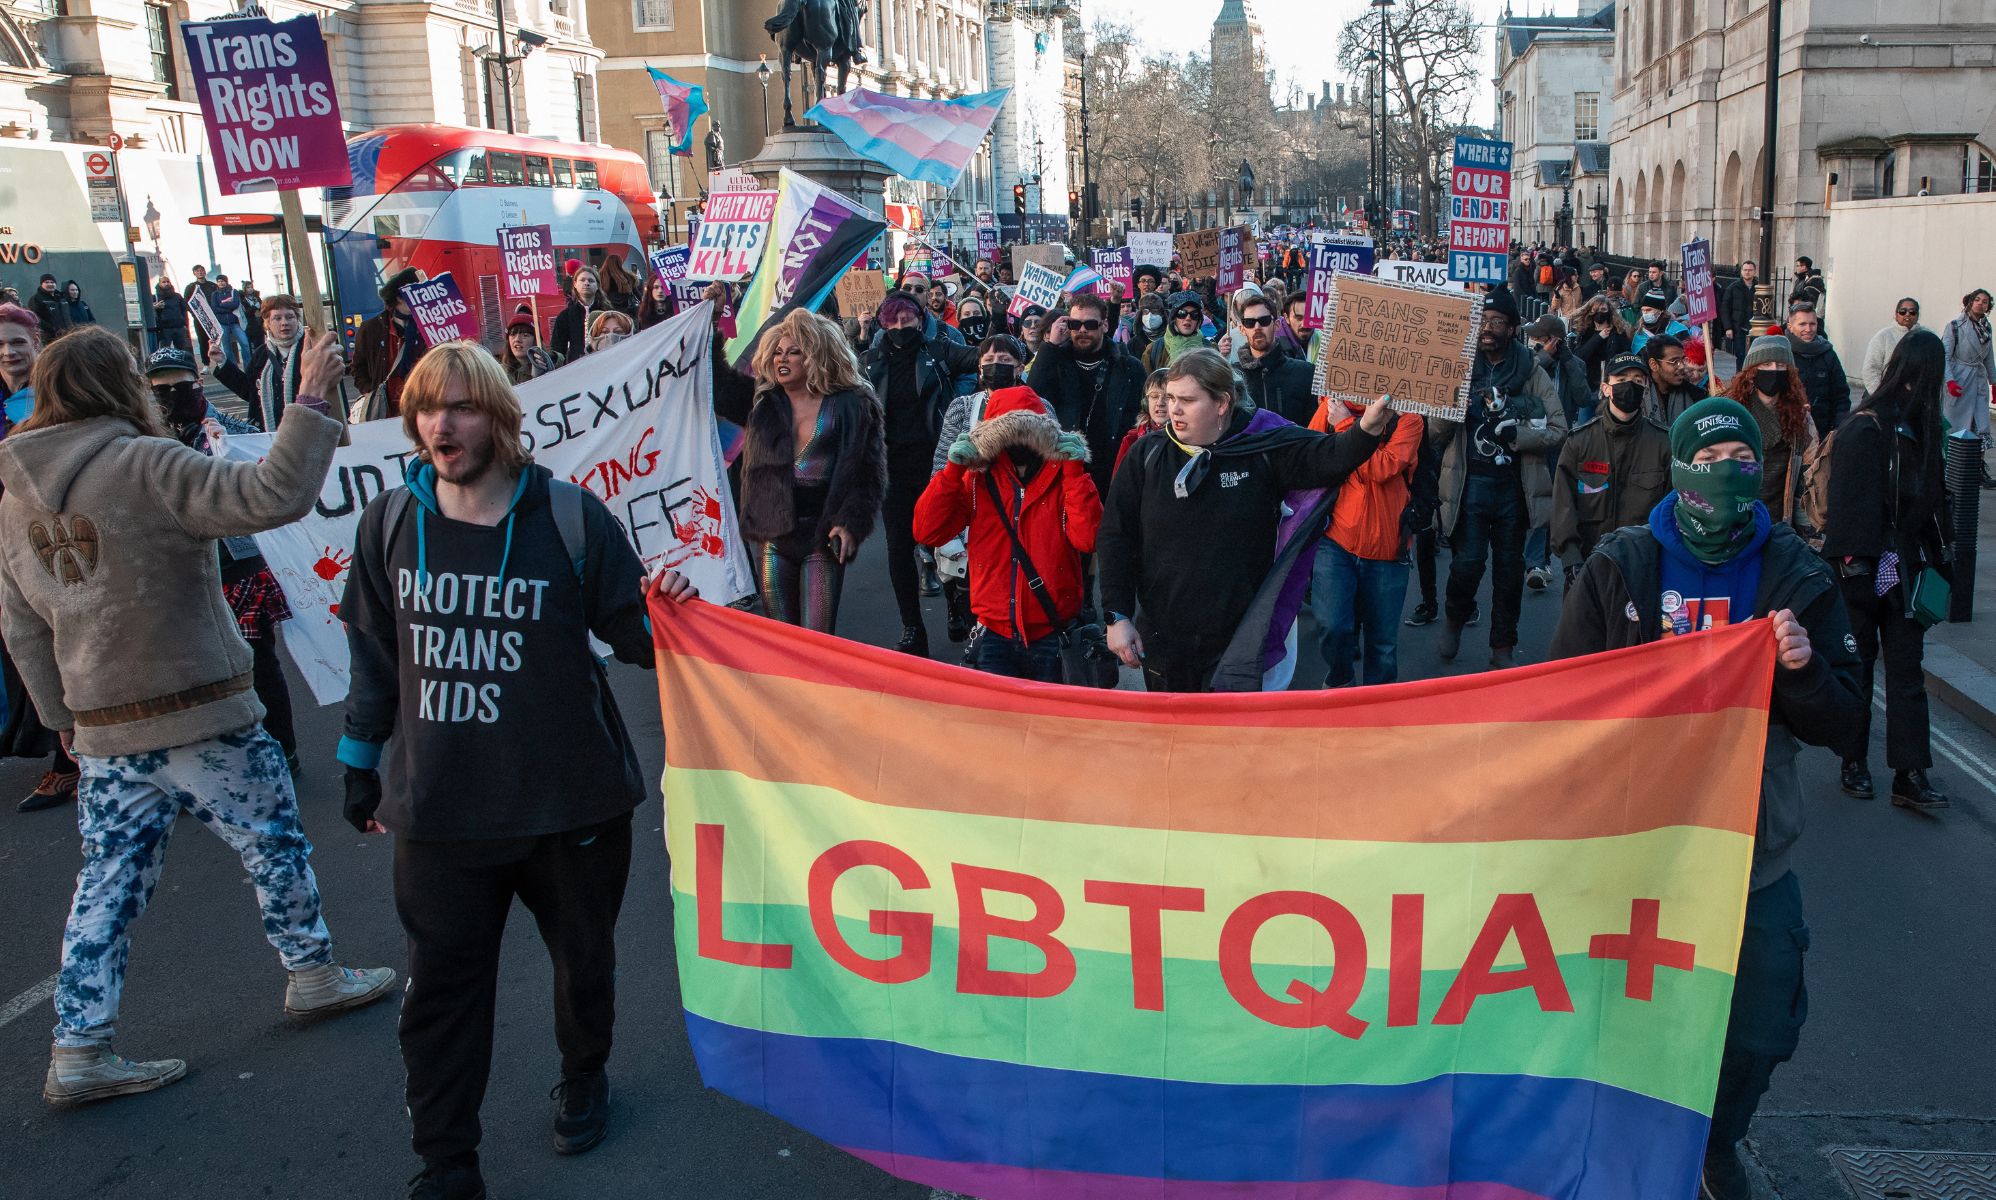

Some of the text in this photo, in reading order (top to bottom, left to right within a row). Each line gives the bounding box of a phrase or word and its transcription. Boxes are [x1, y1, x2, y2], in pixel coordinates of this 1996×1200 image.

[187, 26, 297, 73] Trans
[207, 73, 332, 131] Rights
[219, 127, 300, 174] Now
[1458, 143, 1509, 166] WHERE'S
[1457, 171, 1503, 194] OUR
[709, 195, 773, 221] WAITING
[1452, 197, 1509, 223] GENDER
[499, 228, 541, 250] Trans
[700, 223, 761, 249] LISTS
[1220, 231, 1239, 249] Trans
[1454, 225, 1506, 249] REFORM
[505, 249, 553, 276] Rights
[652, 253, 685, 268] Trans
[693, 250, 749, 276] KILL
[1092, 249, 1123, 264] Trans
[1220, 248, 1243, 270] Rights
[1313, 244, 1359, 270] Trans
[1455, 254, 1502, 280] BILL
[1683, 246, 1706, 269] Trans
[659, 262, 689, 278] Right
[1023, 262, 1063, 292] WAITING
[1095, 263, 1131, 281] Rights
[1394, 266, 1448, 286] TRANS
[1686, 266, 1712, 295] Rights
[401, 282, 448, 306] Trans
[508, 274, 540, 295] Now
[1019, 281, 1056, 308] LISTS
[1096, 280, 1111, 294] No
[414, 298, 467, 325] Rights
[1341, 292, 1428, 325] TRANS
[1689, 294, 1708, 316] Now
[424, 323, 460, 346] Now
[1335, 315, 1432, 346] RIGHTS
[1333, 337, 1469, 379] ARE NOT FOR
[1697, 415, 1739, 431] UNISON
[398, 568, 549, 621] PROTECT
[409, 623, 523, 671] TRANS
[419, 678, 501, 724] KIDS
[694, 823, 1696, 1040] LGBTQIA+
